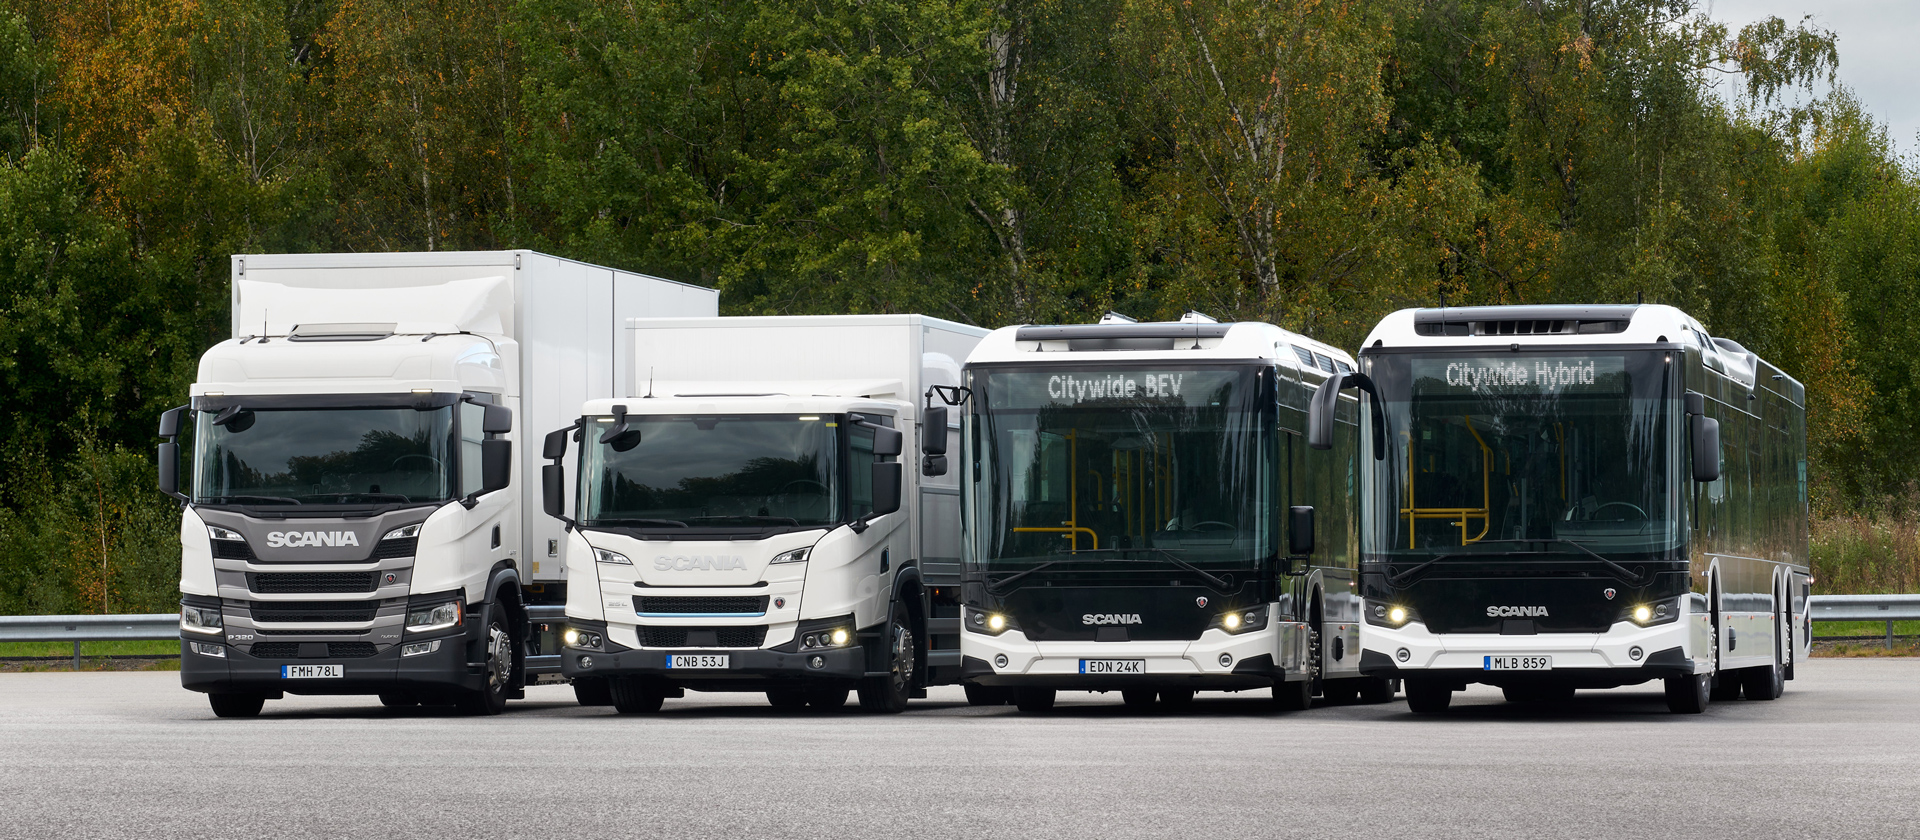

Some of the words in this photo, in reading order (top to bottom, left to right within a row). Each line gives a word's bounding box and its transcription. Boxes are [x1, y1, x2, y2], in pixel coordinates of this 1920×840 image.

[1446, 361, 1528, 391] Citywide
[1535, 360, 1595, 391] Hybrid
[1048, 374, 1137, 403] Citywide
[1145, 373, 1183, 398] BEV
[266, 531, 360, 548] SCANIA
[653, 555, 748, 571] SCANIA
[1486, 605, 1549, 617] SCANIA
[1082, 613, 1143, 625] SCANIA
[676, 656, 698, 667] CNB
[701, 656, 724, 667] 53J
[1090, 661, 1113, 673] EDN
[1116, 661, 1140, 673] 24K
[1494, 657, 1518, 669] MLB
[1522, 657, 1547, 669] 859
[291, 666, 313, 677] FMH
[316, 666, 339, 677] 78L
